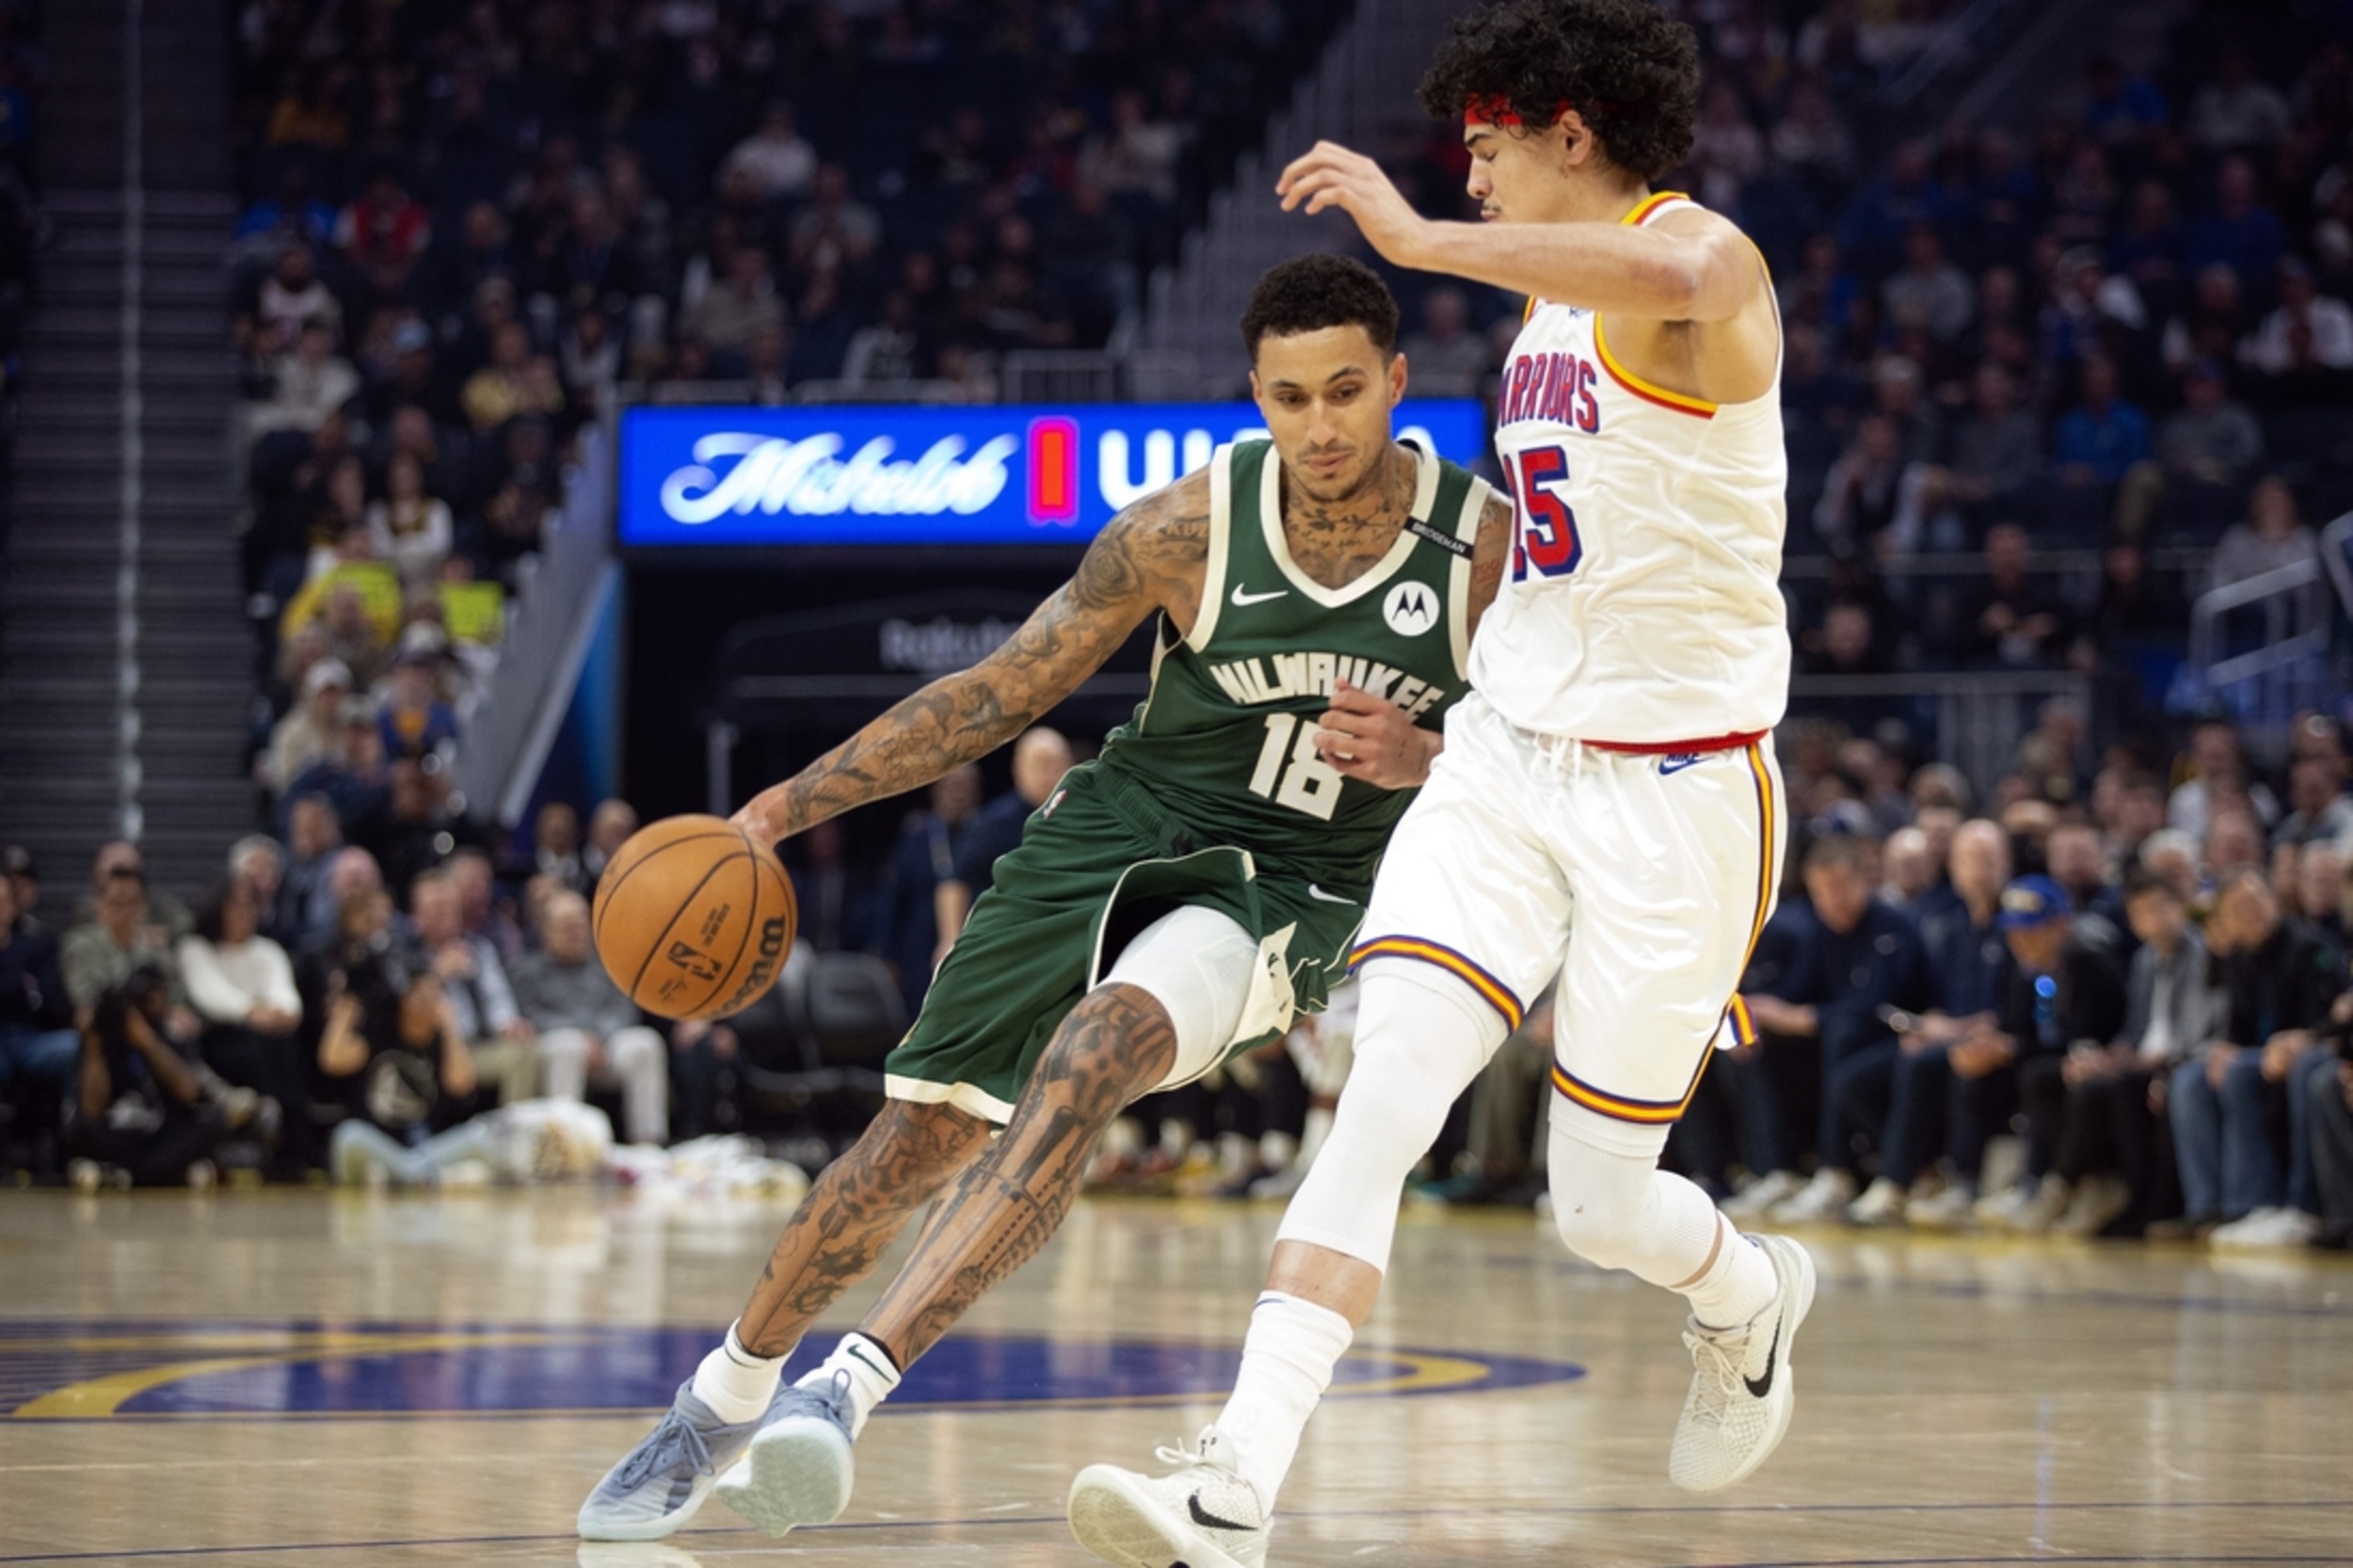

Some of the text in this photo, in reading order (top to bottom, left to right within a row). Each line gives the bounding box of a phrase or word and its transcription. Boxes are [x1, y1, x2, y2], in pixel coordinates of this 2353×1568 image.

[1498, 352, 1599, 434] RRIORS
[661, 431, 1020, 524] Michelob
[879, 616, 1024, 672] Rakut
[1209, 652, 1445, 724] MILWAUKEE
[1248, 712, 1353, 822] 18
[708, 911, 786, 1018] Wilso
